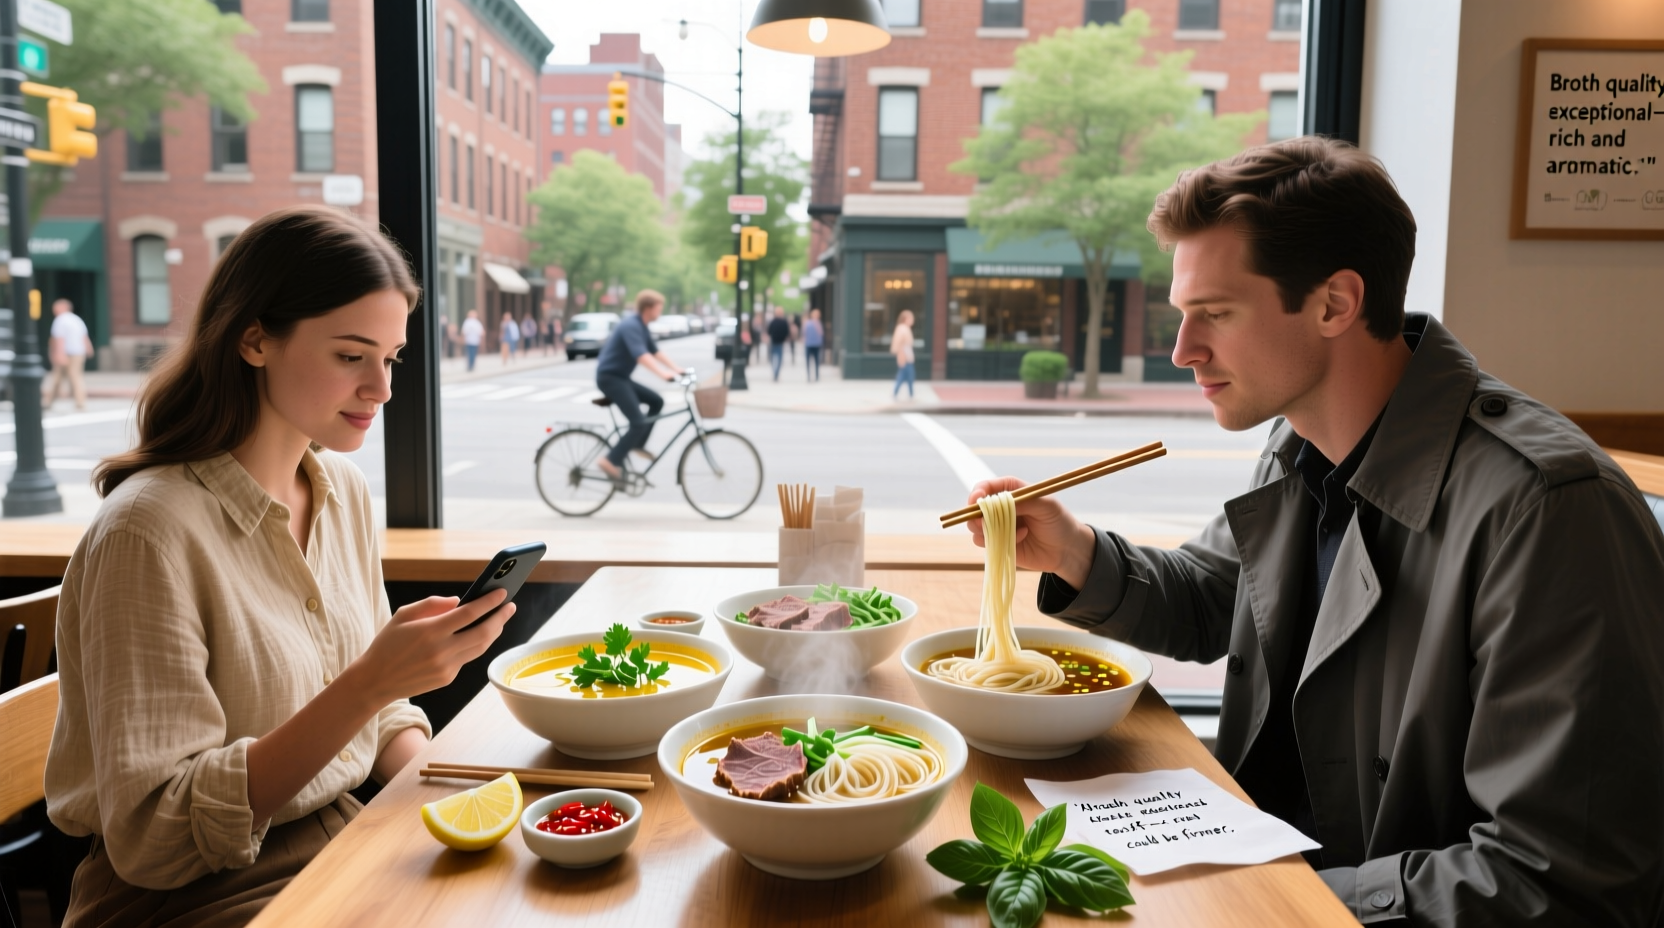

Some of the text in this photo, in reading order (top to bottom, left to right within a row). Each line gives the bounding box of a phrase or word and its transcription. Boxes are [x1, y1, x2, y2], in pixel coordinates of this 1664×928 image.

[1550, 73, 1664, 98] Broth quality
[1549, 128, 1626, 148] rich and
